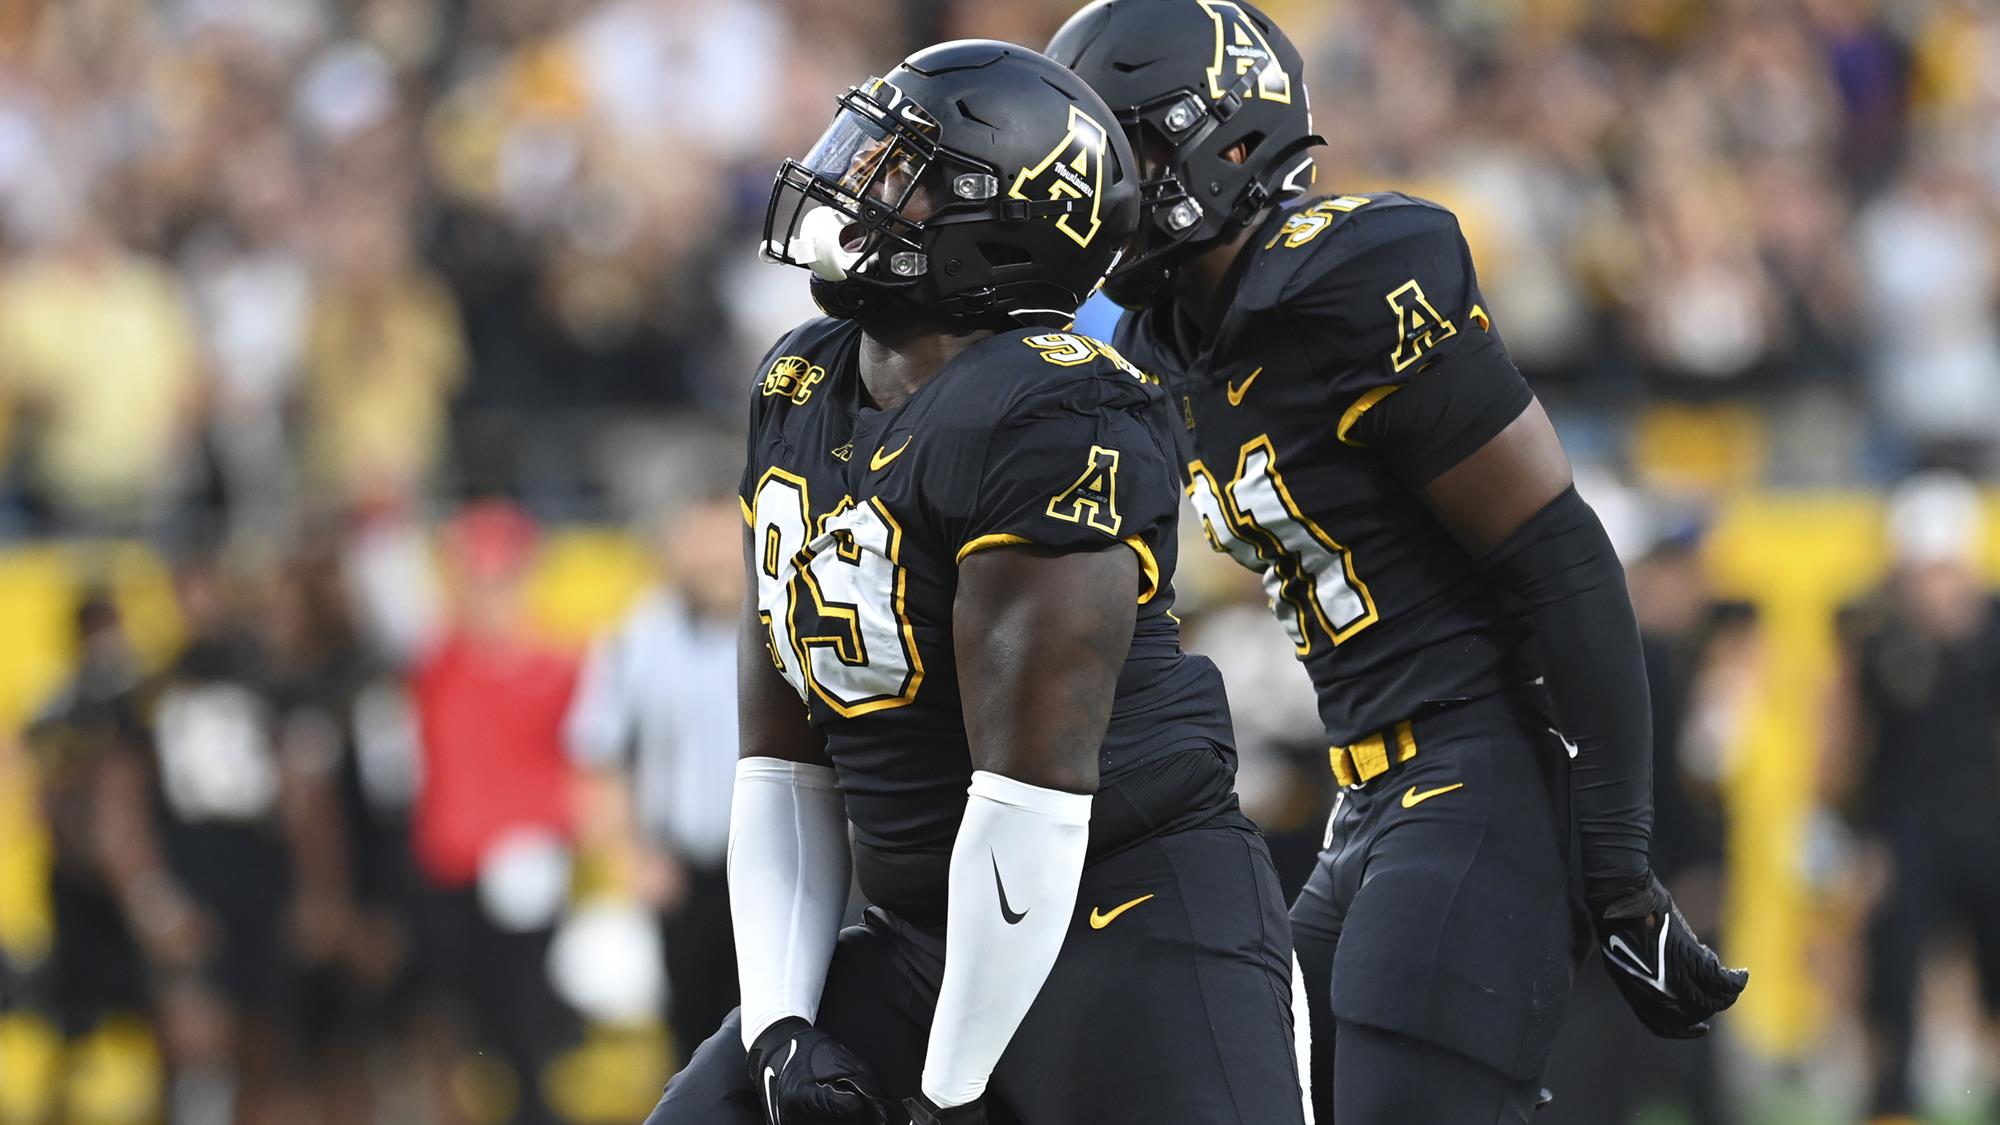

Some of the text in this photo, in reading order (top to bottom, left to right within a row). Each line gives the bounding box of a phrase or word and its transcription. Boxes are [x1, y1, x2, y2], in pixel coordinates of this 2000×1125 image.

[1008, 104, 1107, 248] A
[1386, 279, 1458, 373] A
[1046, 445, 1122, 536] A
[752, 466, 925, 720] 99
